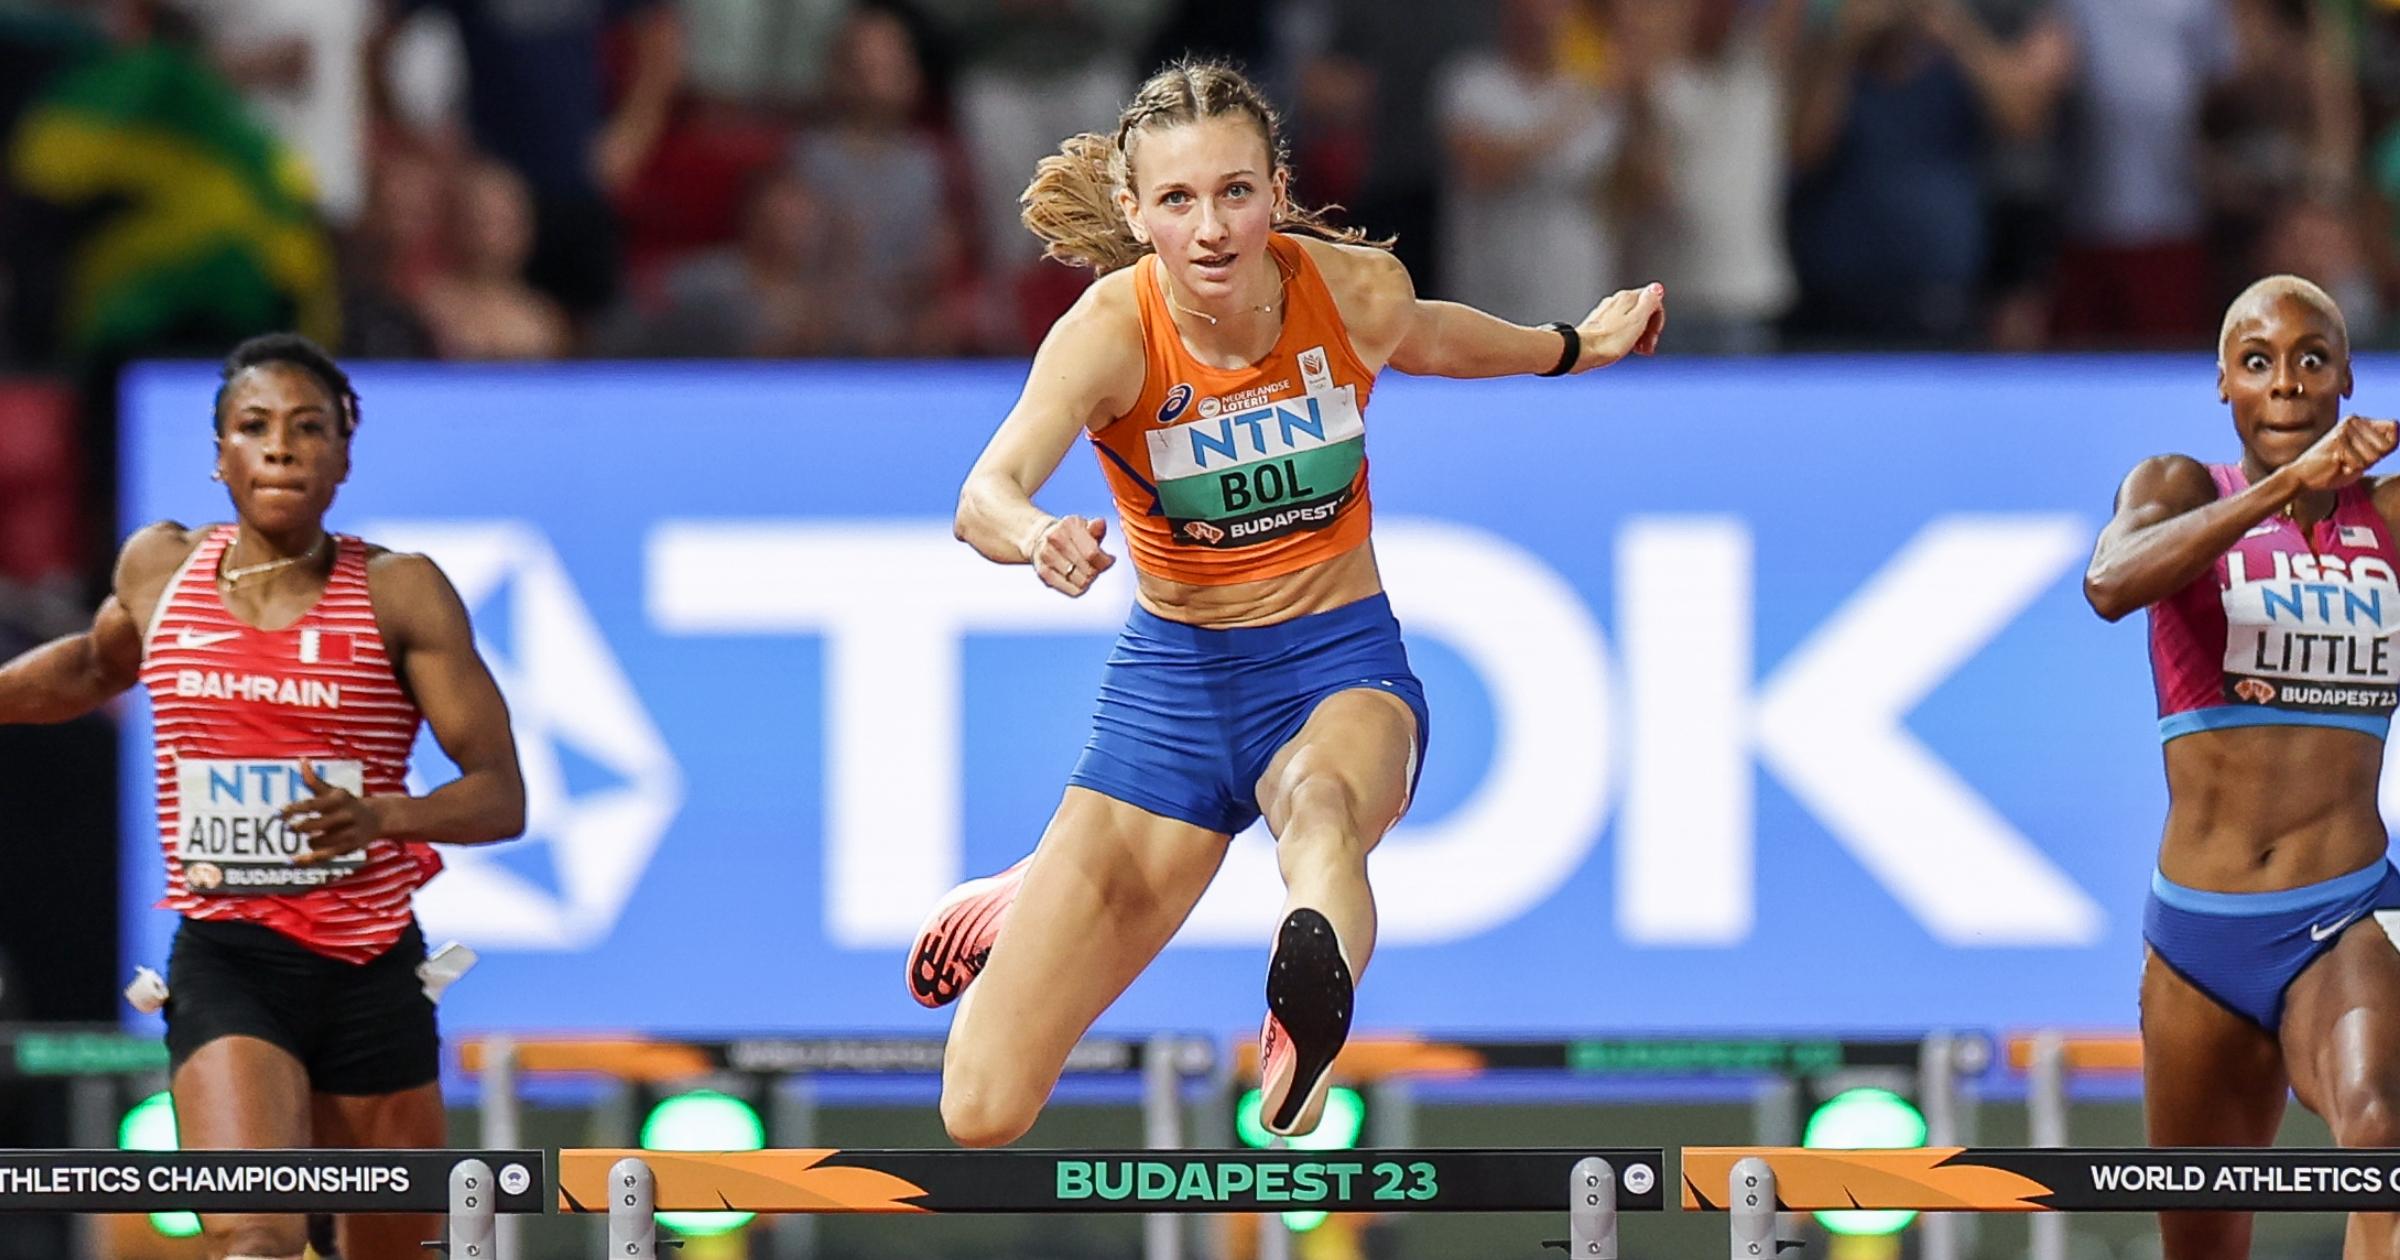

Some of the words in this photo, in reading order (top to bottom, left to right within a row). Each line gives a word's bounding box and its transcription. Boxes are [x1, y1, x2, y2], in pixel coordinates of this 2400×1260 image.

[1222, 380, 1290, 402] NEDERLANDSE
[1222, 397, 1268, 412] LOTERIJ
[1188, 397, 1326, 468] NTN
[1220, 460, 1314, 513] BOL
[1230, 501, 1337, 537] BUDAPEST
[2262, 583, 2382, 627] NTN
[2255, 631, 2390, 676] LITTLE
[177, 669, 340, 709] BAHRAIN
[2281, 686, 2378, 706] BUDAPEST
[209, 764, 327, 806] NTN
[187, 815, 304, 857] ADEKO
[224, 867, 329, 885] BUDAPEST
[147, 1167, 410, 1193] CHAMPIONSHIPS
[1056, 1161, 1362, 1201] BUDAPEST
[1373, 1162, 1439, 1200] 23
[2091, 1166, 2205, 1192] WORLD
[2213, 1166, 2382, 1193] ATHLETICS
